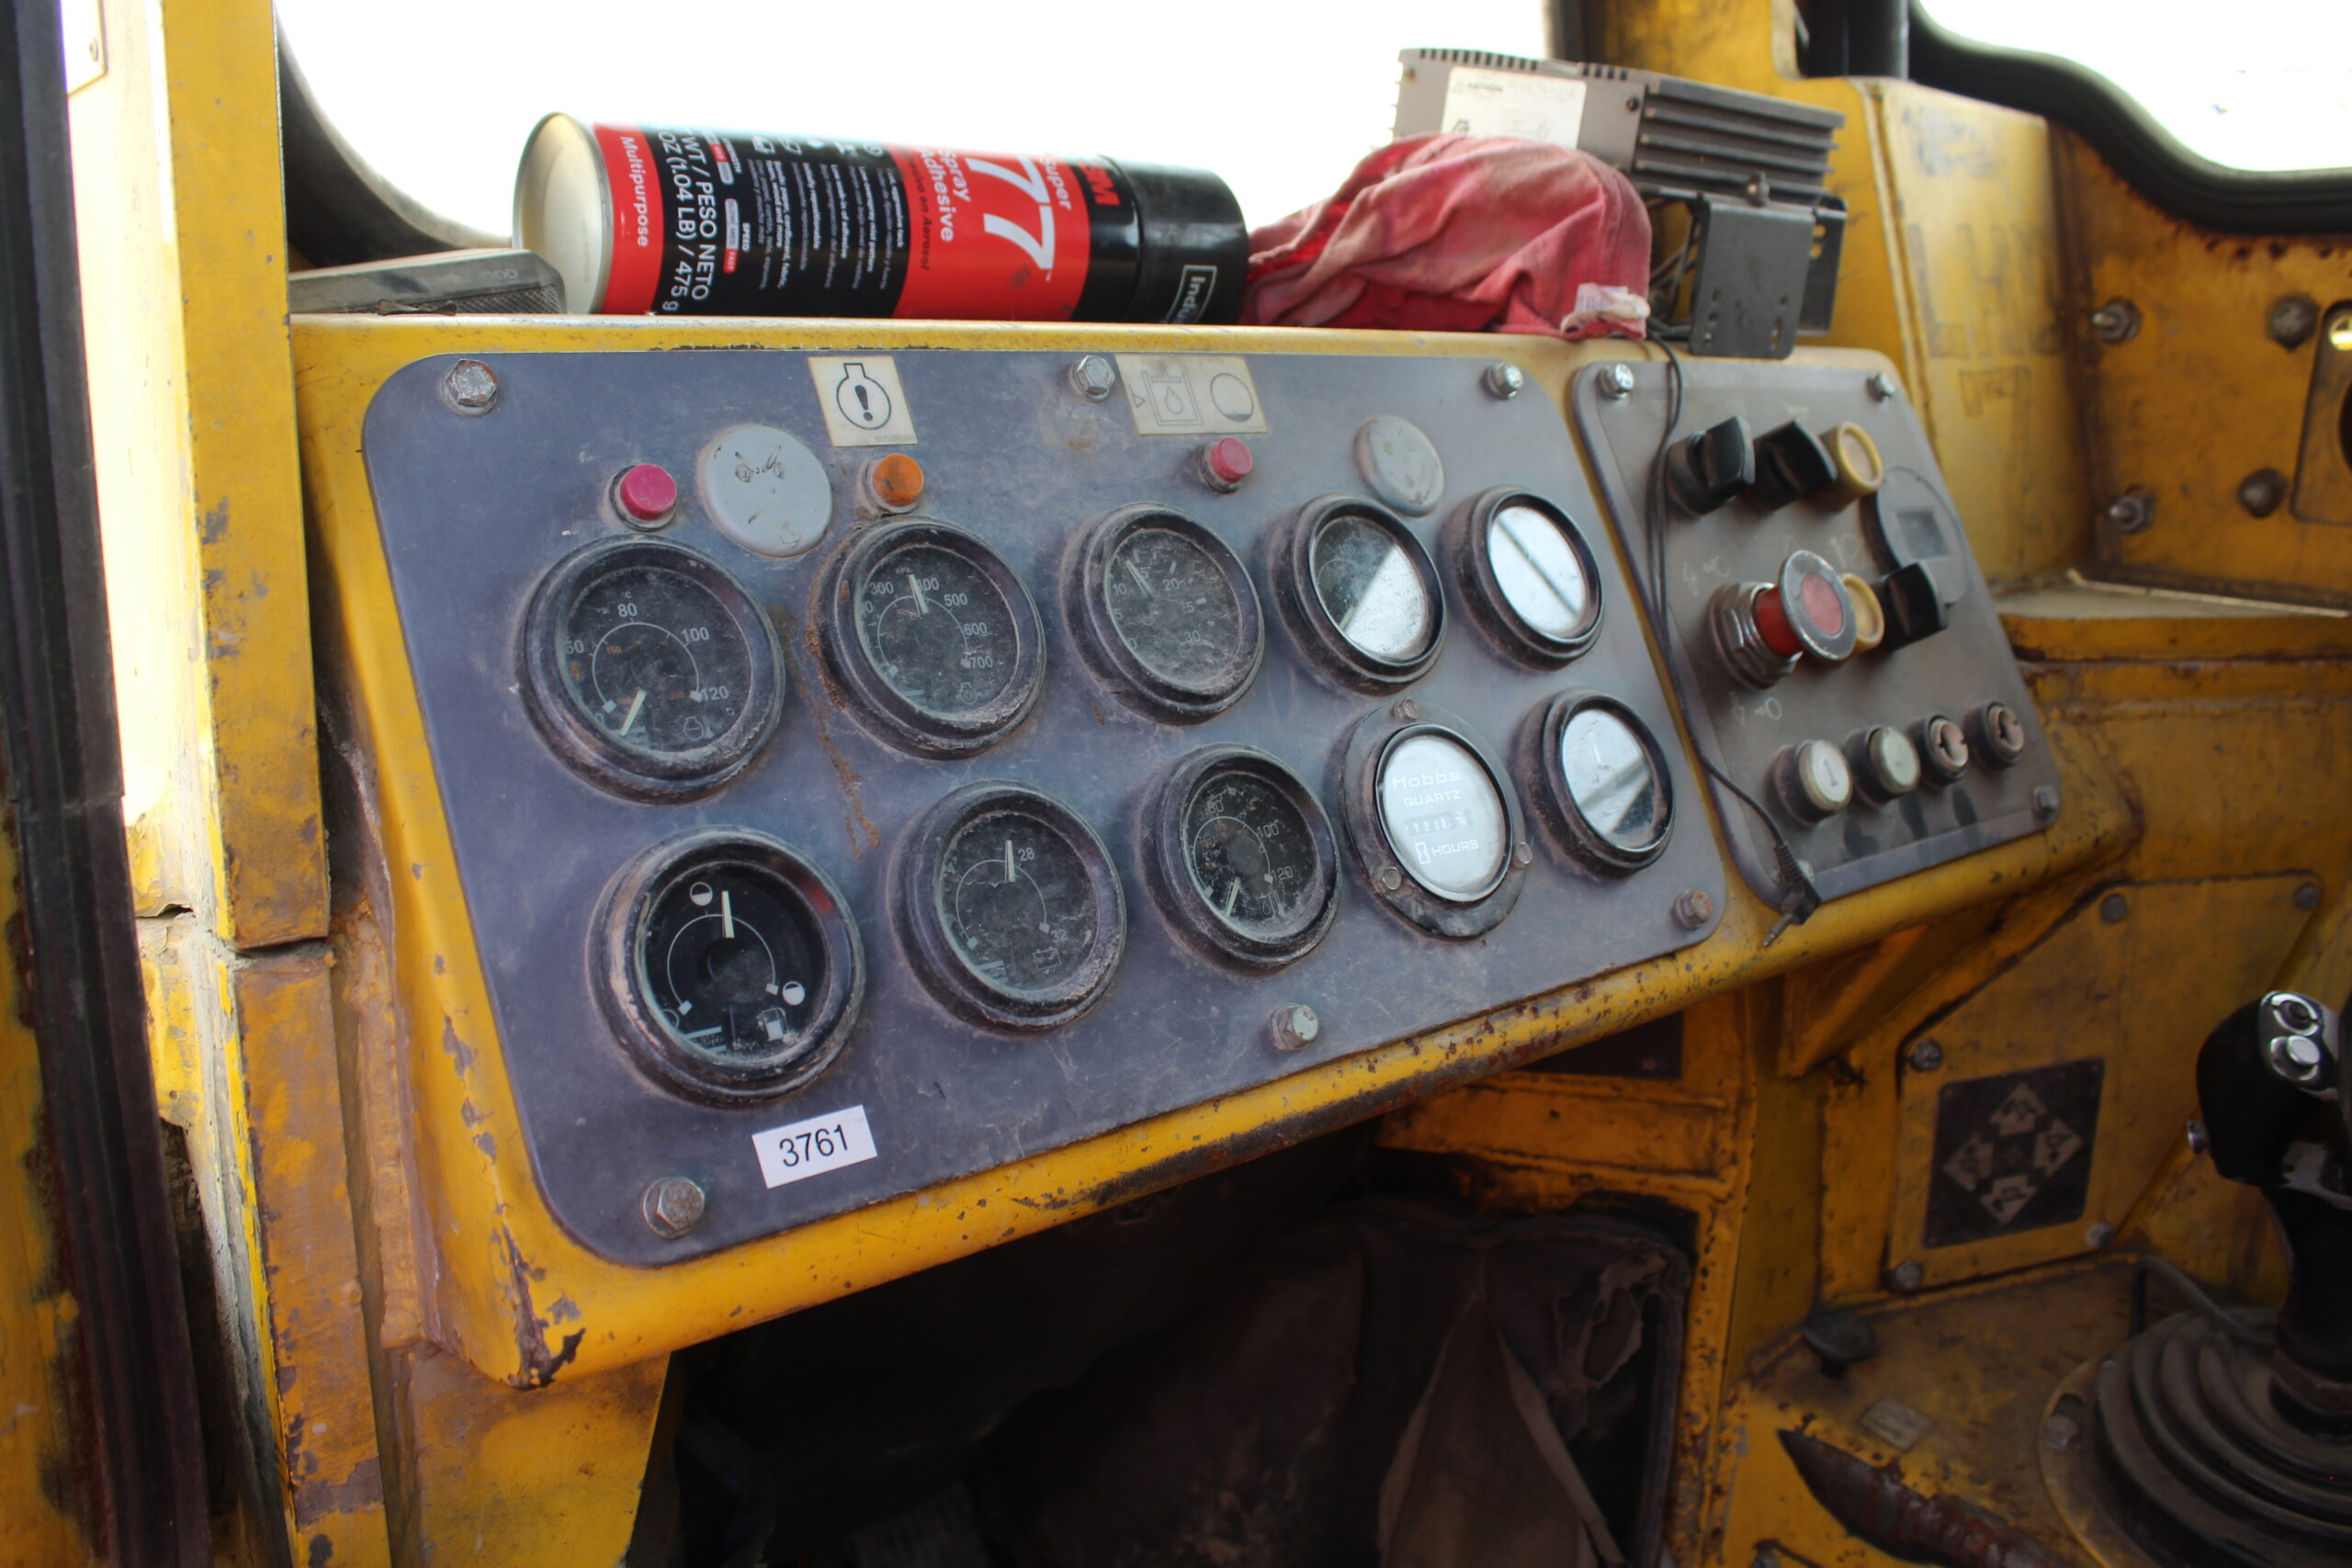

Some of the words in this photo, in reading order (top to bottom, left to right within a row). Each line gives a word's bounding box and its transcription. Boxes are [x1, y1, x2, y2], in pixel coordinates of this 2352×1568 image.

[659, 130, 684, 154] OZ
[681, 136, 707, 164] WT
[666, 157, 694, 201] (1.04
[937, 148, 971, 201] Spray
[1038, 154, 1072, 211] Super
[620, 136, 650, 248] Multipurpose
[916, 147, 956, 243] Adhesive
[695, 181, 718, 239] PESO
[965, 156, 1056, 269] 77
[675, 207, 697, 240] LB)
[742, 222, 751, 252] SPEED
[841, 221, 850, 259] adhesive
[920, 216, 933, 270] Aerosol
[727, 250, 737, 272] FAST
[671, 261, 694, 298] 475
[691, 244, 717, 301] NETO
[662, 300, 679, 312] g
[869, 581, 894, 595] 300
[1162, 577, 1180, 591] 20
[616, 603, 638, 617] 80
[944, 592, 968, 607] 500
[681, 627, 710, 643] 100
[964, 621, 988, 637] 600
[969, 655, 994, 670] 700
[701, 686, 729, 701] 120
[1393, 772, 1462, 790] Hobbs
[1206, 800, 1224, 814] 80
[1404, 790, 1463, 807] QUARTZ
[1256, 823, 1279, 838] 100
[1018, 848, 1035, 862] 28
[1431, 840, 1479, 856] HOURS
[1272, 866, 1294, 882] 120
[779, 1124, 848, 1167] 3761
